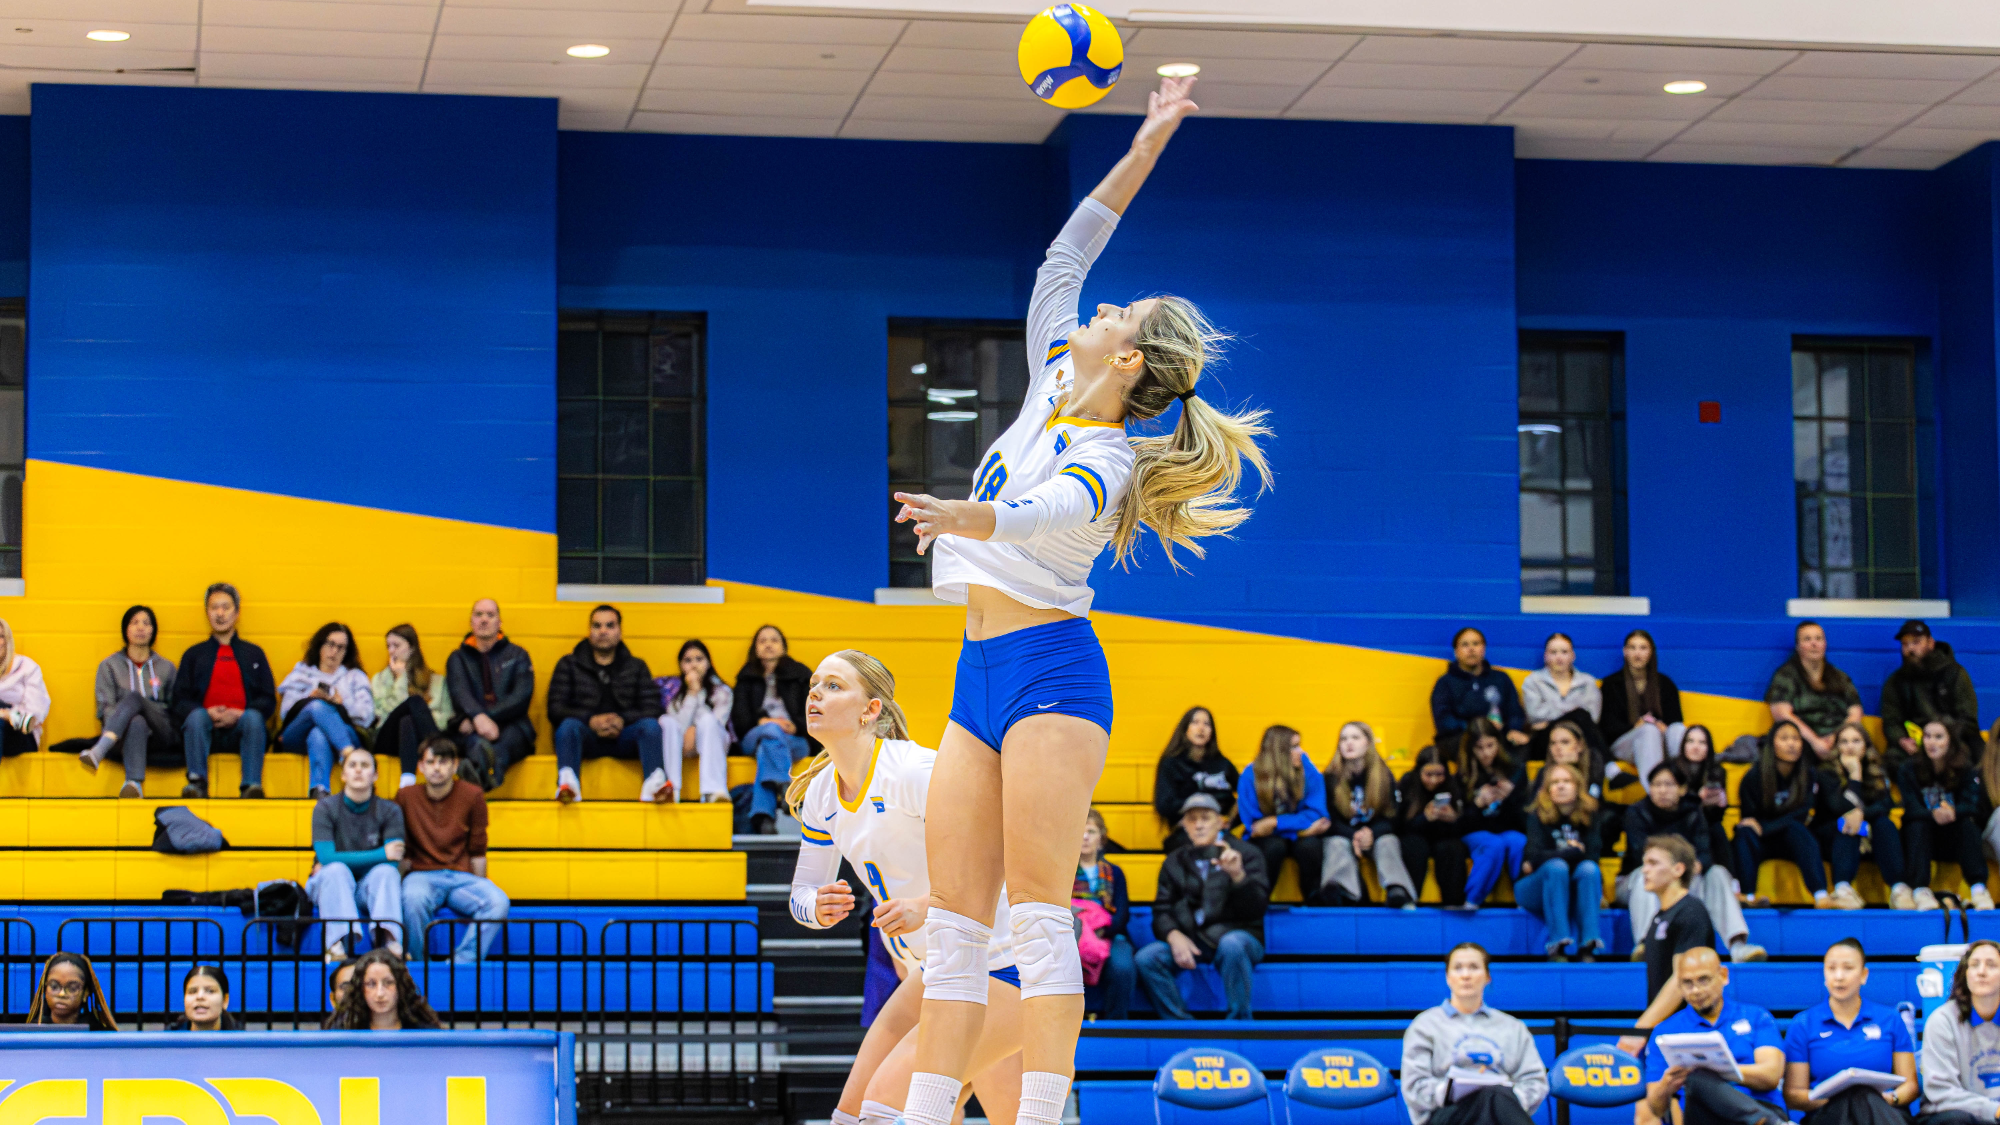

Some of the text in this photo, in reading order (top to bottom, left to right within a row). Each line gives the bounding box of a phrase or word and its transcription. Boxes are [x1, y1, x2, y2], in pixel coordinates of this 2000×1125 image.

[863, 861, 891, 903] 9
[1193, 1056, 1225, 1069] TMU
[1322, 1056, 1354, 1067] TMU
[1583, 1054, 1615, 1066] TMU
[1172, 1068, 1250, 1090] BOLD
[1301, 1067, 1380, 1089] BOLD
[1563, 1065, 1641, 1087] BOLD
